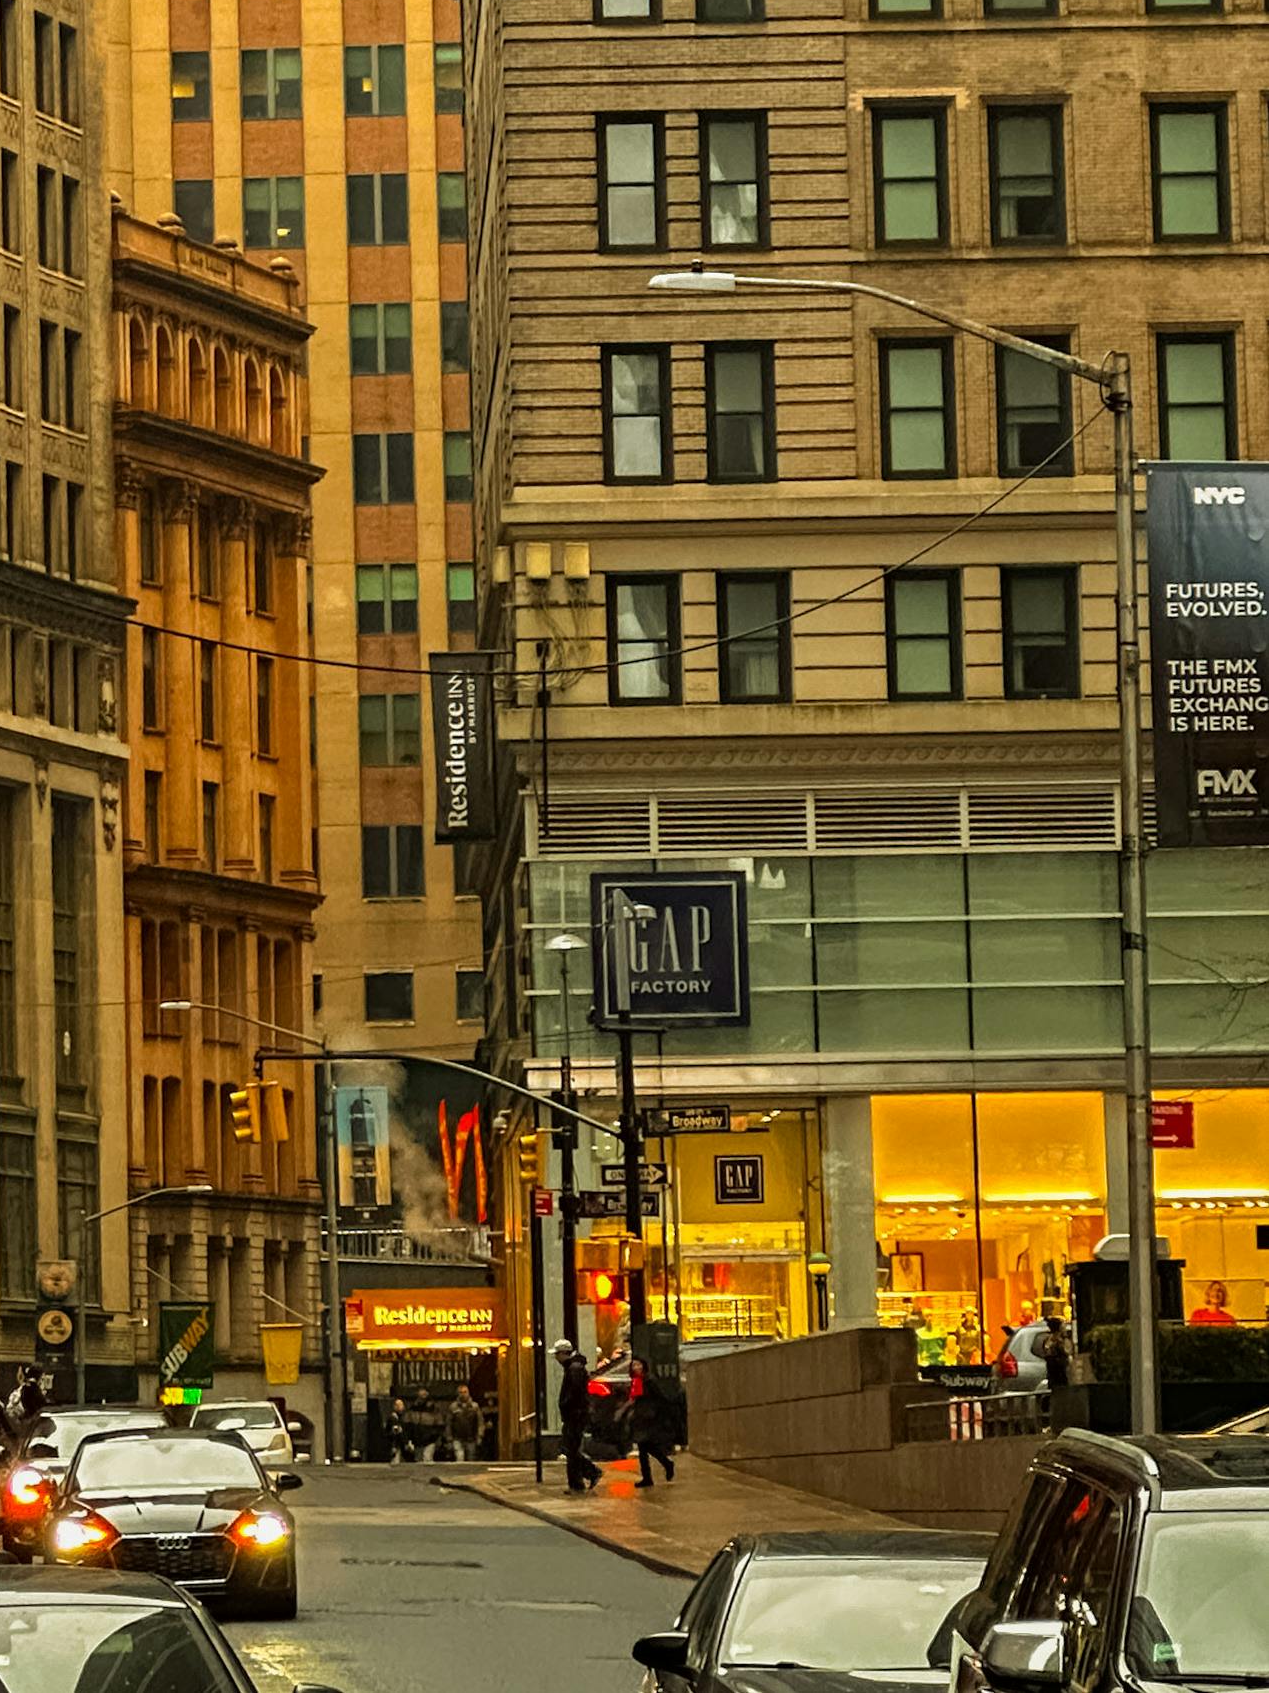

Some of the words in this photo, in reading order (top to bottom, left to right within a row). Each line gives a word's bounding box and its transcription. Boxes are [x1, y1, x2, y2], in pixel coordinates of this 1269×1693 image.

[1193, 487, 1246, 505] NYC
[1166, 582, 1265, 599] FUTURES,
[1166, 601, 1268, 618] EVOLVED.
[1167, 660, 1208, 676] THE
[1214, 659, 1257, 675] FMX
[1169, 678, 1262, 694] FUTURES
[467, 670, 477, 728] MARRIOT
[1170, 697, 1269, 714] EXCHANG
[1171, 716, 1188, 732] IS
[1194, 715, 1254, 732] HERE.
[468, 734, 478, 745] BY
[445, 701, 469, 828] Residence
[1197, 768, 1258, 796] FMX
[629, 905, 711, 974] GAP
[630, 979, 712, 995] FACTORY
[672, 1114, 723, 1128] Broadway
[725, 1164, 753, 1187] GAP
[373, 1305, 468, 1326] Residence
[160, 1307, 210, 1383] SUBWAY
[939, 1374, 990, 1389] Subway
